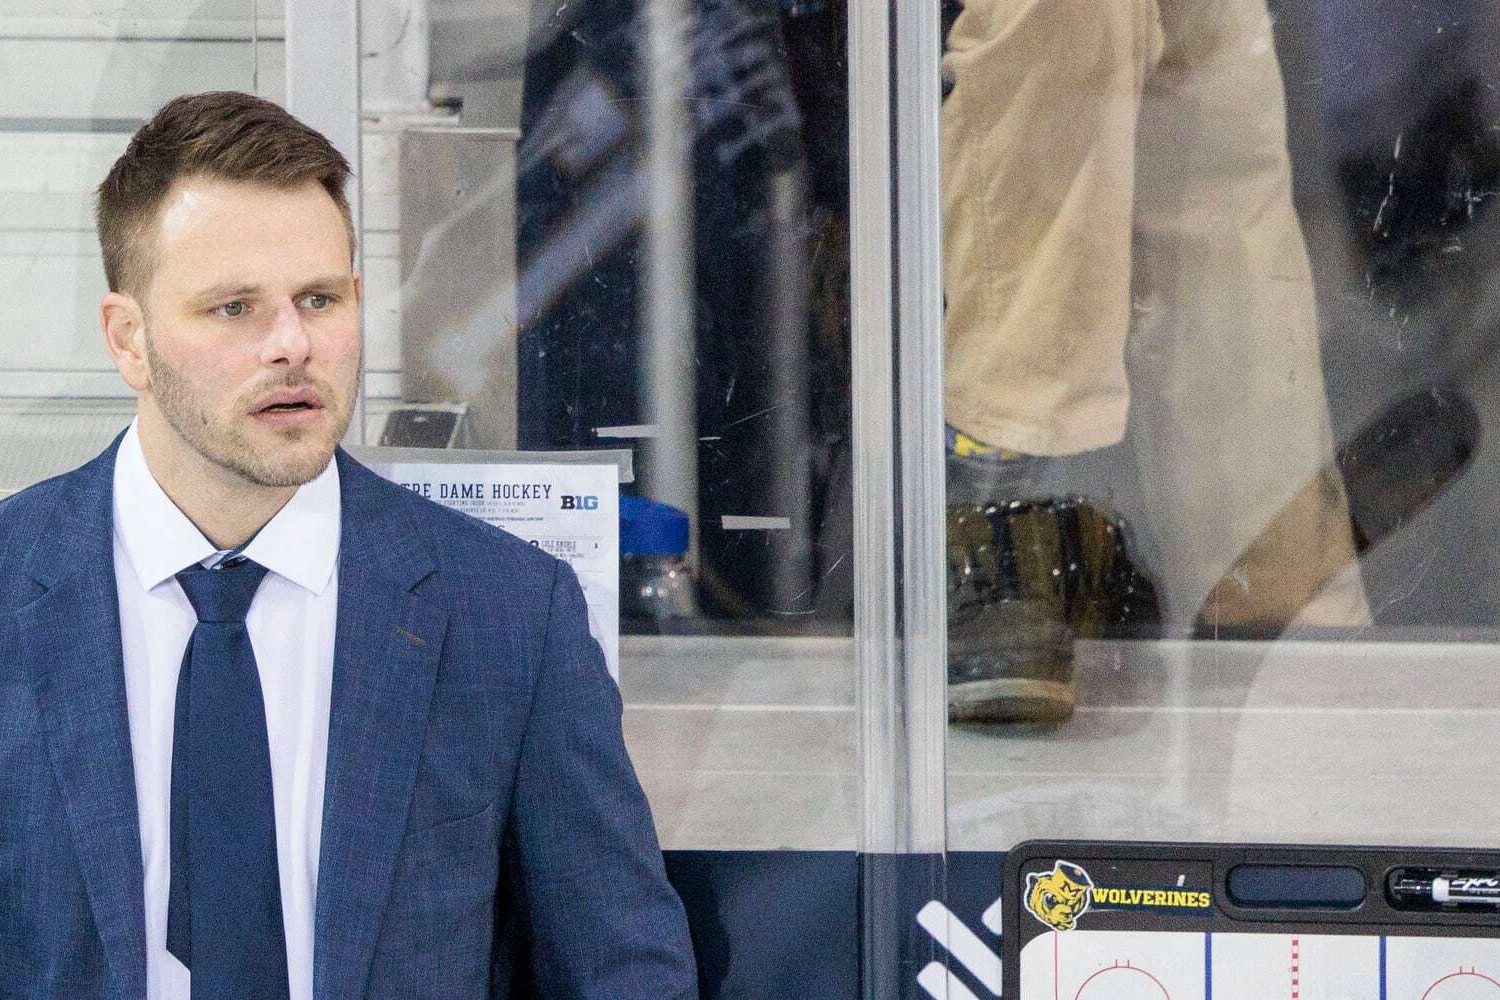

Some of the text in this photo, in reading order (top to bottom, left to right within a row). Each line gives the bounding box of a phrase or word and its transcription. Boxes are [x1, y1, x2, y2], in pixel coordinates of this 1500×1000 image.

[440, 484, 484, 499] DAME
[492, 484, 552, 499] HOCKEY
[1092, 887, 1211, 908] WOLVERINES
